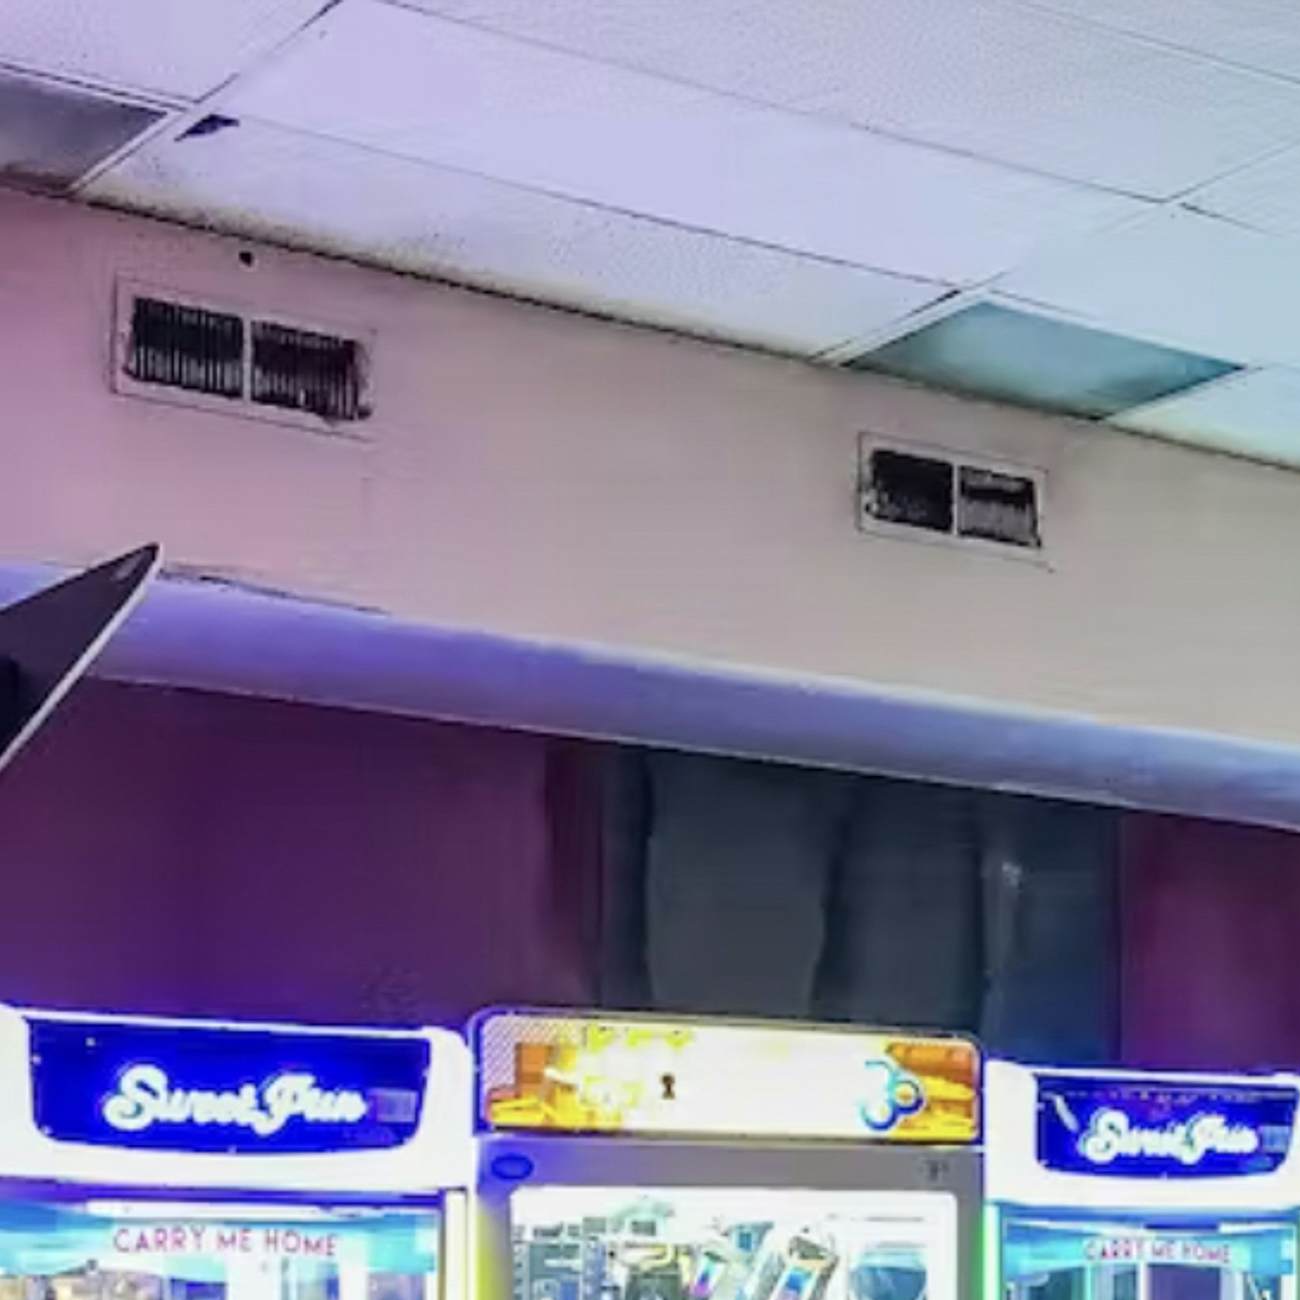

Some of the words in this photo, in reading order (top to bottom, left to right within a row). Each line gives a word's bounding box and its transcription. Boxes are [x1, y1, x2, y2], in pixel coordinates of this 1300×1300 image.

[112, 1224, 207, 1253] CARRY
[216, 1229, 252, 1250] ME
[264, 1229, 338, 1257] HOME
